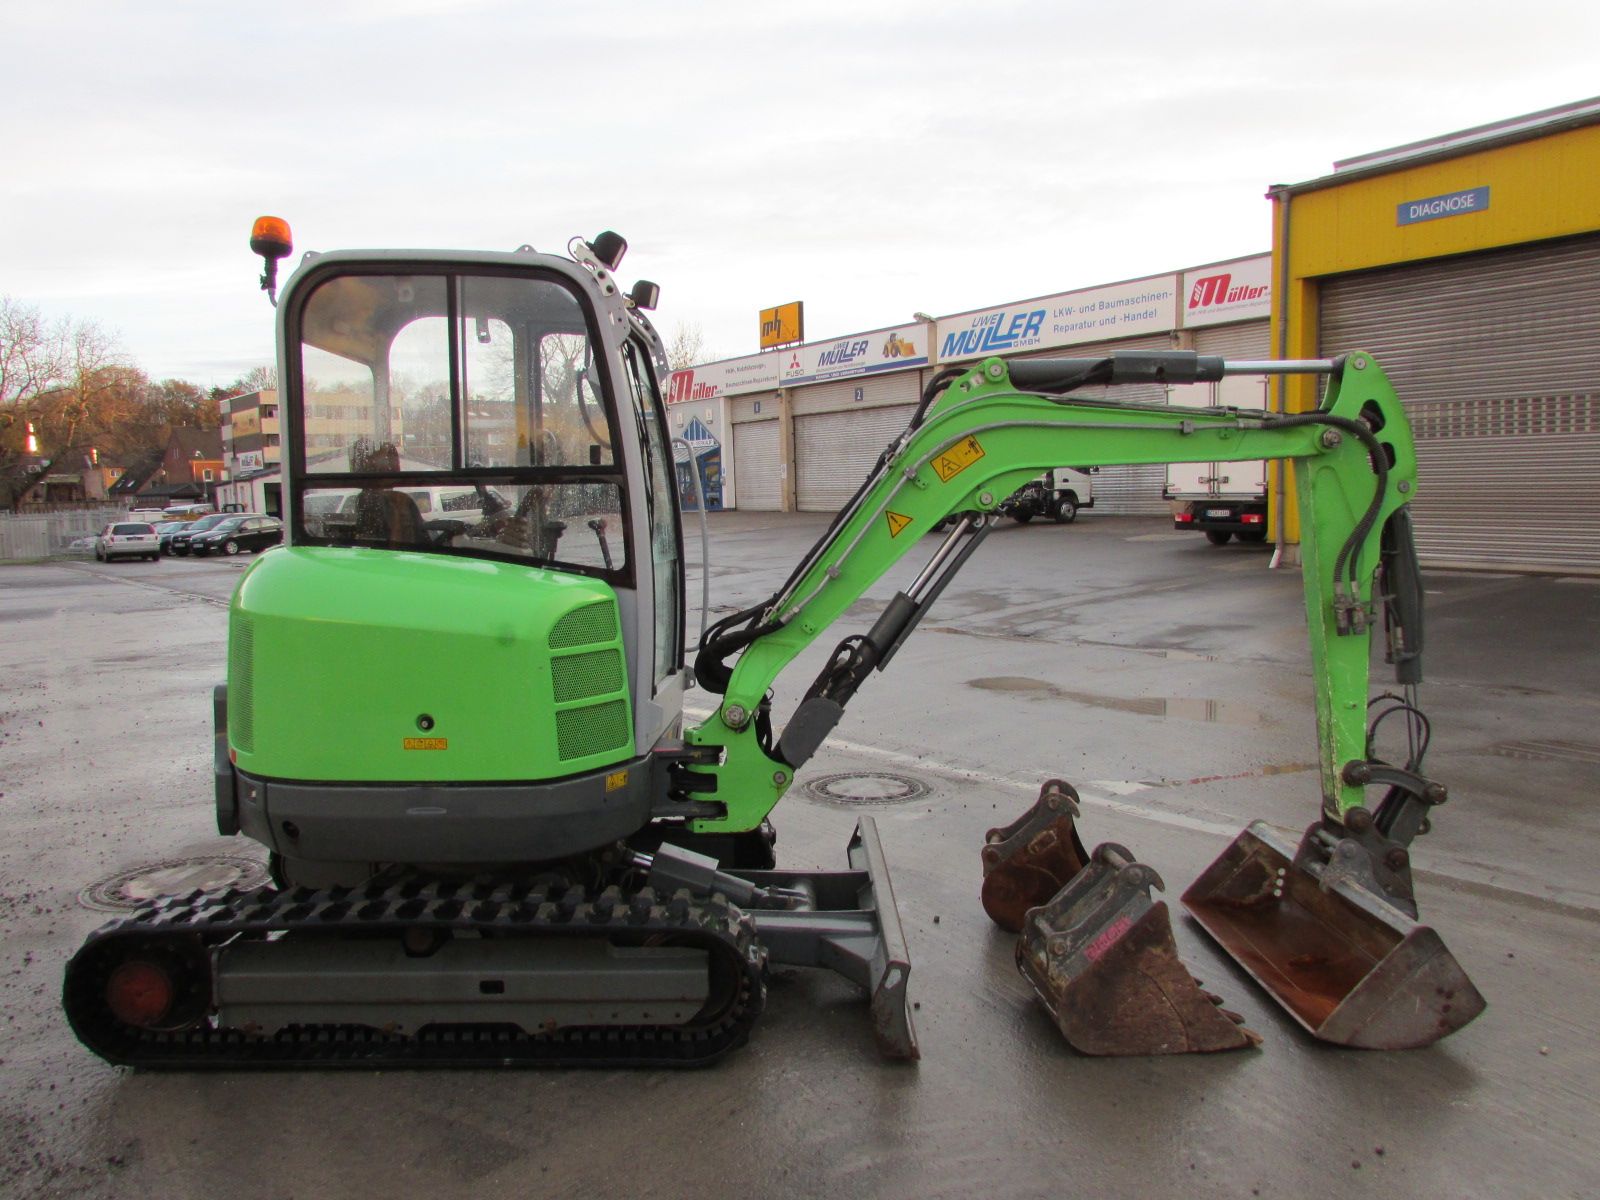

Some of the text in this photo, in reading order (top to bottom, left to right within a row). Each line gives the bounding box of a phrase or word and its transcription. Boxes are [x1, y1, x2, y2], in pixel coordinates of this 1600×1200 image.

[1409, 193, 1475, 219] DIAGNOSE
[1053, 291, 1173, 318] LKW- und Baumaschinen-
[1188, 274, 1269, 309] Müller
[971, 313, 998, 327] UWE
[1053, 308, 1157, 334] Reparatur und -Handel
[833, 341, 847, 350] UWE
[940, 309, 1047, 358] MÜLLER
[1013, 337, 1041, 348] GMBH
[817, 340, 869, 367] MÜLLER
[668, 369, 718, 403] Müller
[786, 369, 804, 377] FUSO
